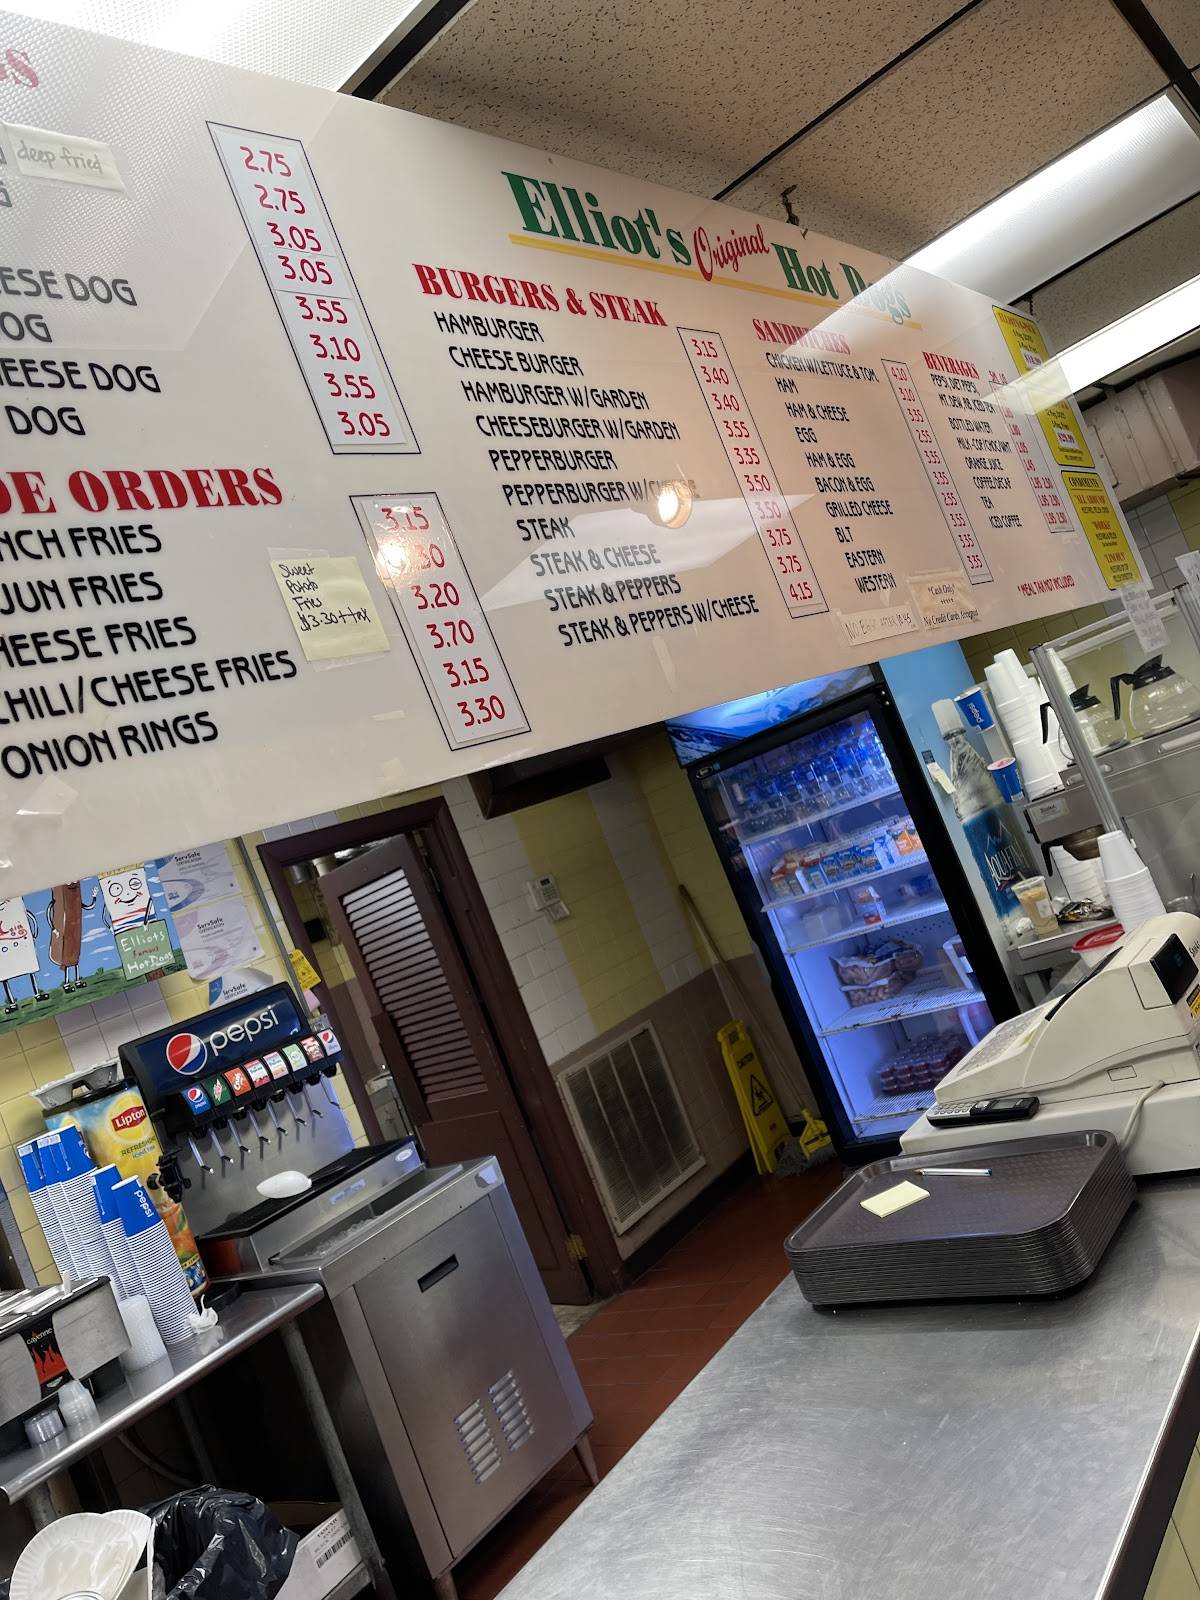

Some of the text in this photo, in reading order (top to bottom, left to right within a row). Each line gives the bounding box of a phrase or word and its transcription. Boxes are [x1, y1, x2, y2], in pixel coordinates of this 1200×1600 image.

[17, 139, 56, 170] deep
[60, 146, 103, 174] fried
[240, 146, 292, 177] 2.75
[254, 184, 306, 214] 2.75
[266, 222, 322, 252] 3.05
[501, 170, 692, 266] Elliot's
[692, 223, 770, 281] Original
[771, 242, 839, 299] Hot
[277, 255, 333, 285] 3.05
[0, 266, 138, 307] ESE DOG
[412, 263, 668, 327] BURGERS & STEAK
[295, 295, 348, 324] 3.55
[0, 311, 53, 343] OG
[434, 311, 545, 343] HAMBURGER
[752, 318, 851, 355] SANDWICHES
[309, 334, 361, 362] 3.10
[691, 339, 718, 358] 3.15
[0, 358, 161, 393] EESE DOG
[701, 366, 730, 385] 3.40
[766, 352, 807, 374] CHICKEN
[850, 365, 862, 380] &
[922, 351, 980, 380] BEVERAGES
[323, 373, 376, 399] 3.55
[461, 380, 650, 410] HAMBURGER W/GARDEN
[774, 376, 799, 394] HAM
[711, 393, 740, 412] 3.40
[784, 401, 850, 422] HAM & CHEESE
[5, 405, 86, 436] DOG
[337, 411, 391, 437] 3.05
[475, 414, 681, 440] CHEESEBURGER W/GARDEN
[723, 420, 750, 438] 3.55
[948, 417, 974, 432] BOTTLED
[795, 426, 818, 443] EGG
[488, 449, 618, 473] PEPPERBURGER
[733, 447, 761, 465] 3.35
[806, 452, 856, 469] HAM & EGG
[965, 456, 989, 470] ORANGE
[0, 467, 283, 514] E ORDERS
[502, 482, 632, 507] PEPPERBURGER
[744, 474, 771, 492] 3.50
[815, 477, 850, 493] BACON
[855, 476, 875, 493] EGG
[755, 501, 782, 520] 3.50
[825, 499, 894, 518] GRILLED CHEESE
[980, 496, 994, 509] TEA
[381, 506, 430, 532] 3.15
[516, 516, 576, 541] STEAK
[988, 514, 1023, 528] ICED COFFEE
[67, 524, 162, 558] FRIES
[766, 528, 792, 547] 3.75
[834, 527, 854, 543] BLT
[278, 562, 315, 578] Sweet
[529, 543, 661, 577] STEAK & CHEESE
[777, 555, 802, 574] 3.75
[845, 549, 886, 568] EASTERN
[68, 571, 163, 608] FRIES
[285, 577, 319, 595] Potato
[410, 581, 460, 610] 3.20
[543, 574, 682, 612] STEAK & PEPPERS
[789, 581, 813, 601] 4.15
[855, 572, 897, 593] WESTERN
[291, 596, 323, 612] Fries
[427, 619, 475, 648] 3.70
[558, 594, 760, 647] STEAK & PEPPERS W/CHEESE
[104, 616, 197, 655] FRIES
[443, 657, 490, 687] 3.15
[0, 650, 298, 724] HILI/CHEESE FRIES
[457, 695, 505, 727] 3.30
[1, 711, 219, 780] ONION RINGS
[120, 931, 165, 952] Elliots
[127, 959, 149, 974] Hot
[209, 1004, 279, 1056] pepsi
[115, 1109, 146, 1128] Lipton
[134, 1189, 155, 1219] pepsi
[26, 1327, 53, 1345] cayenne
